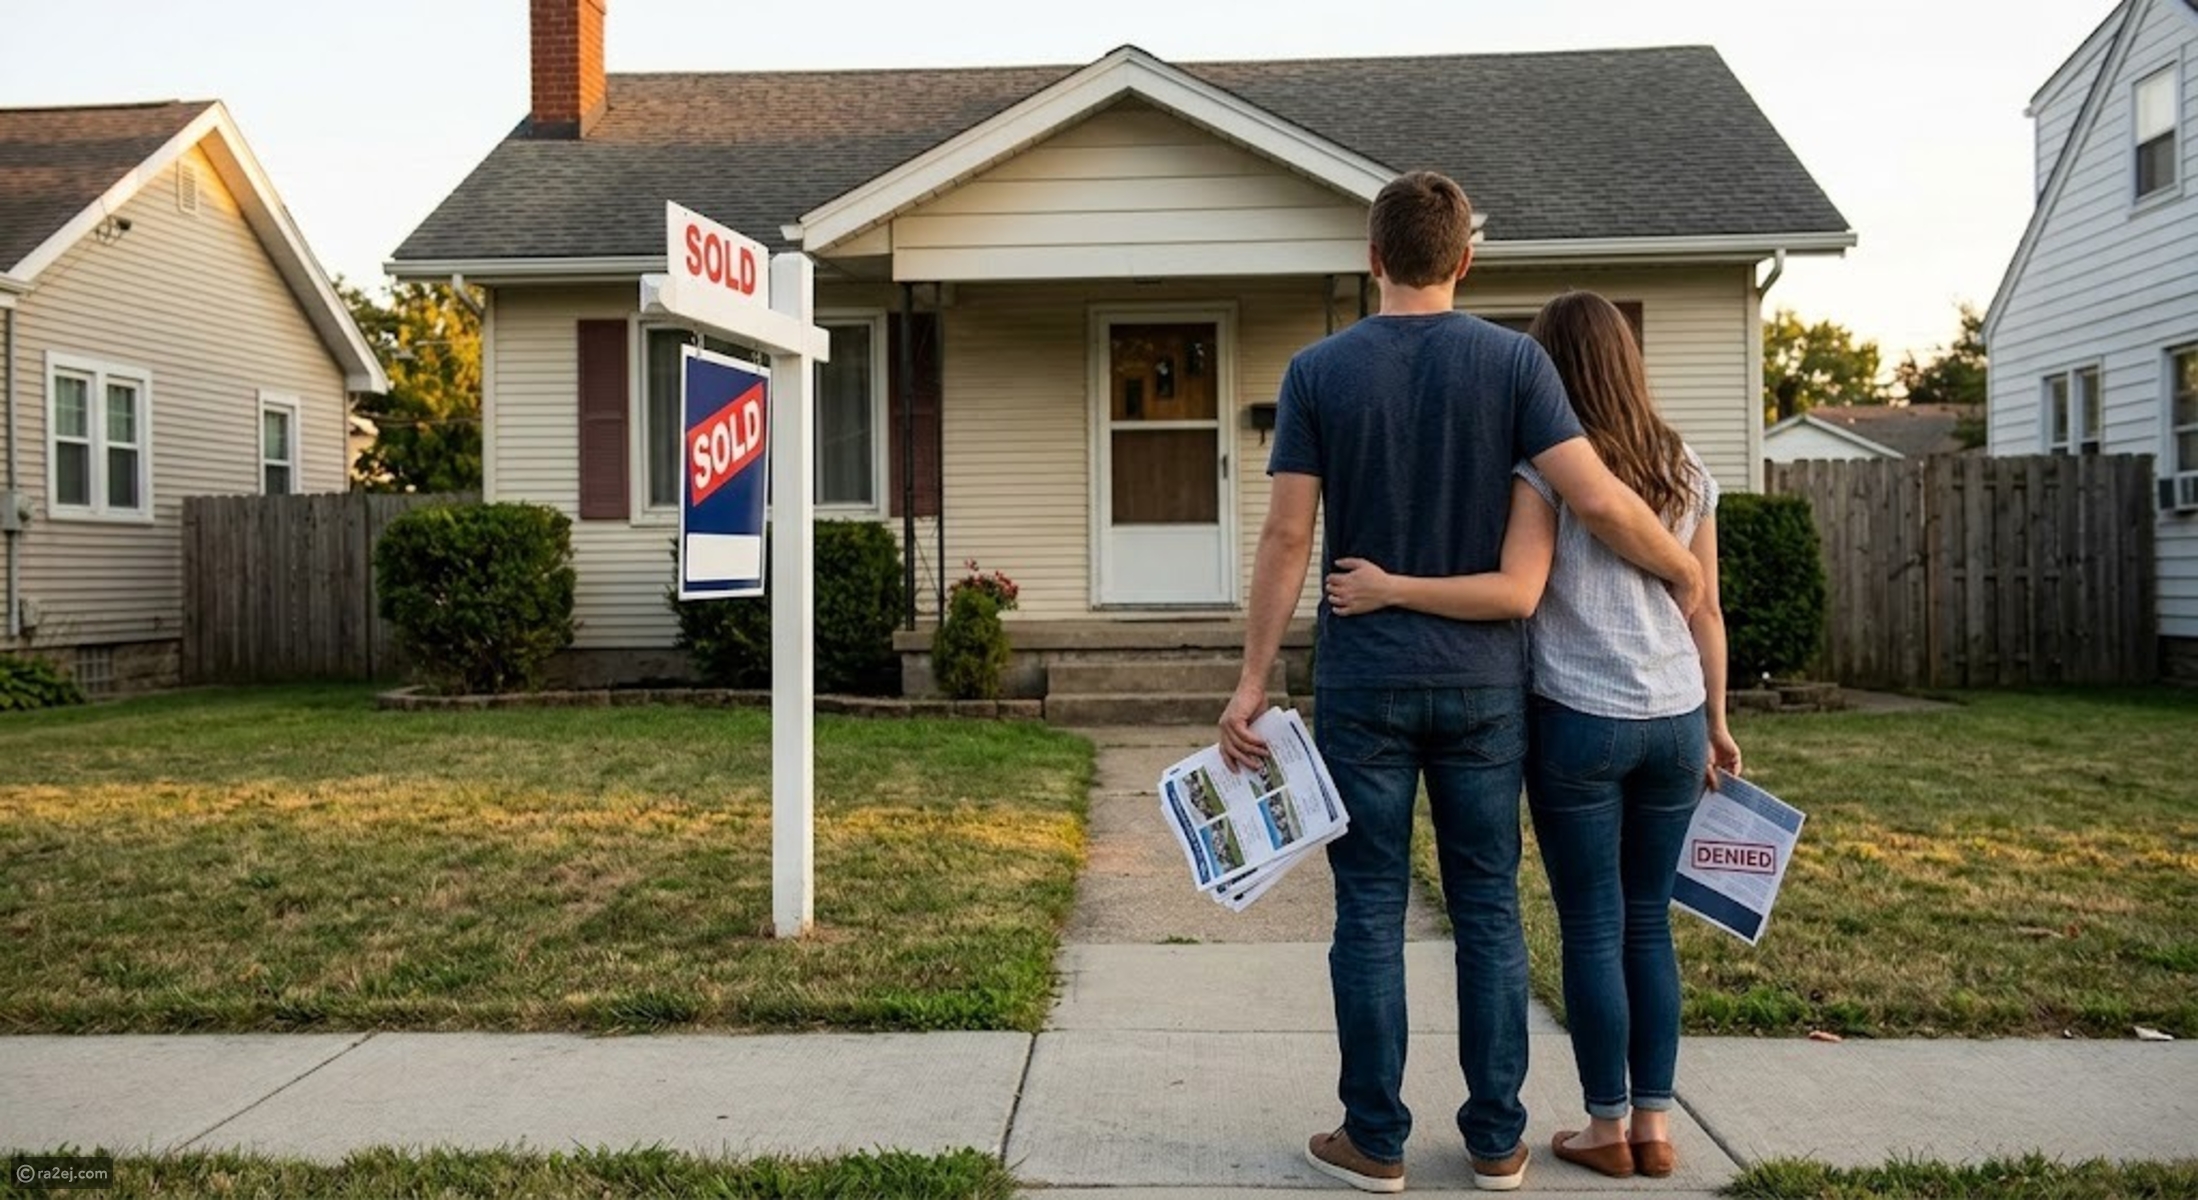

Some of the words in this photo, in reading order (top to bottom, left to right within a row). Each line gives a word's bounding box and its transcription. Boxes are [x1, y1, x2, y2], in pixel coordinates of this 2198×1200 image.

[686, 223, 756, 296] SOLD
[693, 399, 761, 489] SOLD
[1697, 847, 1772, 868] DENIED
